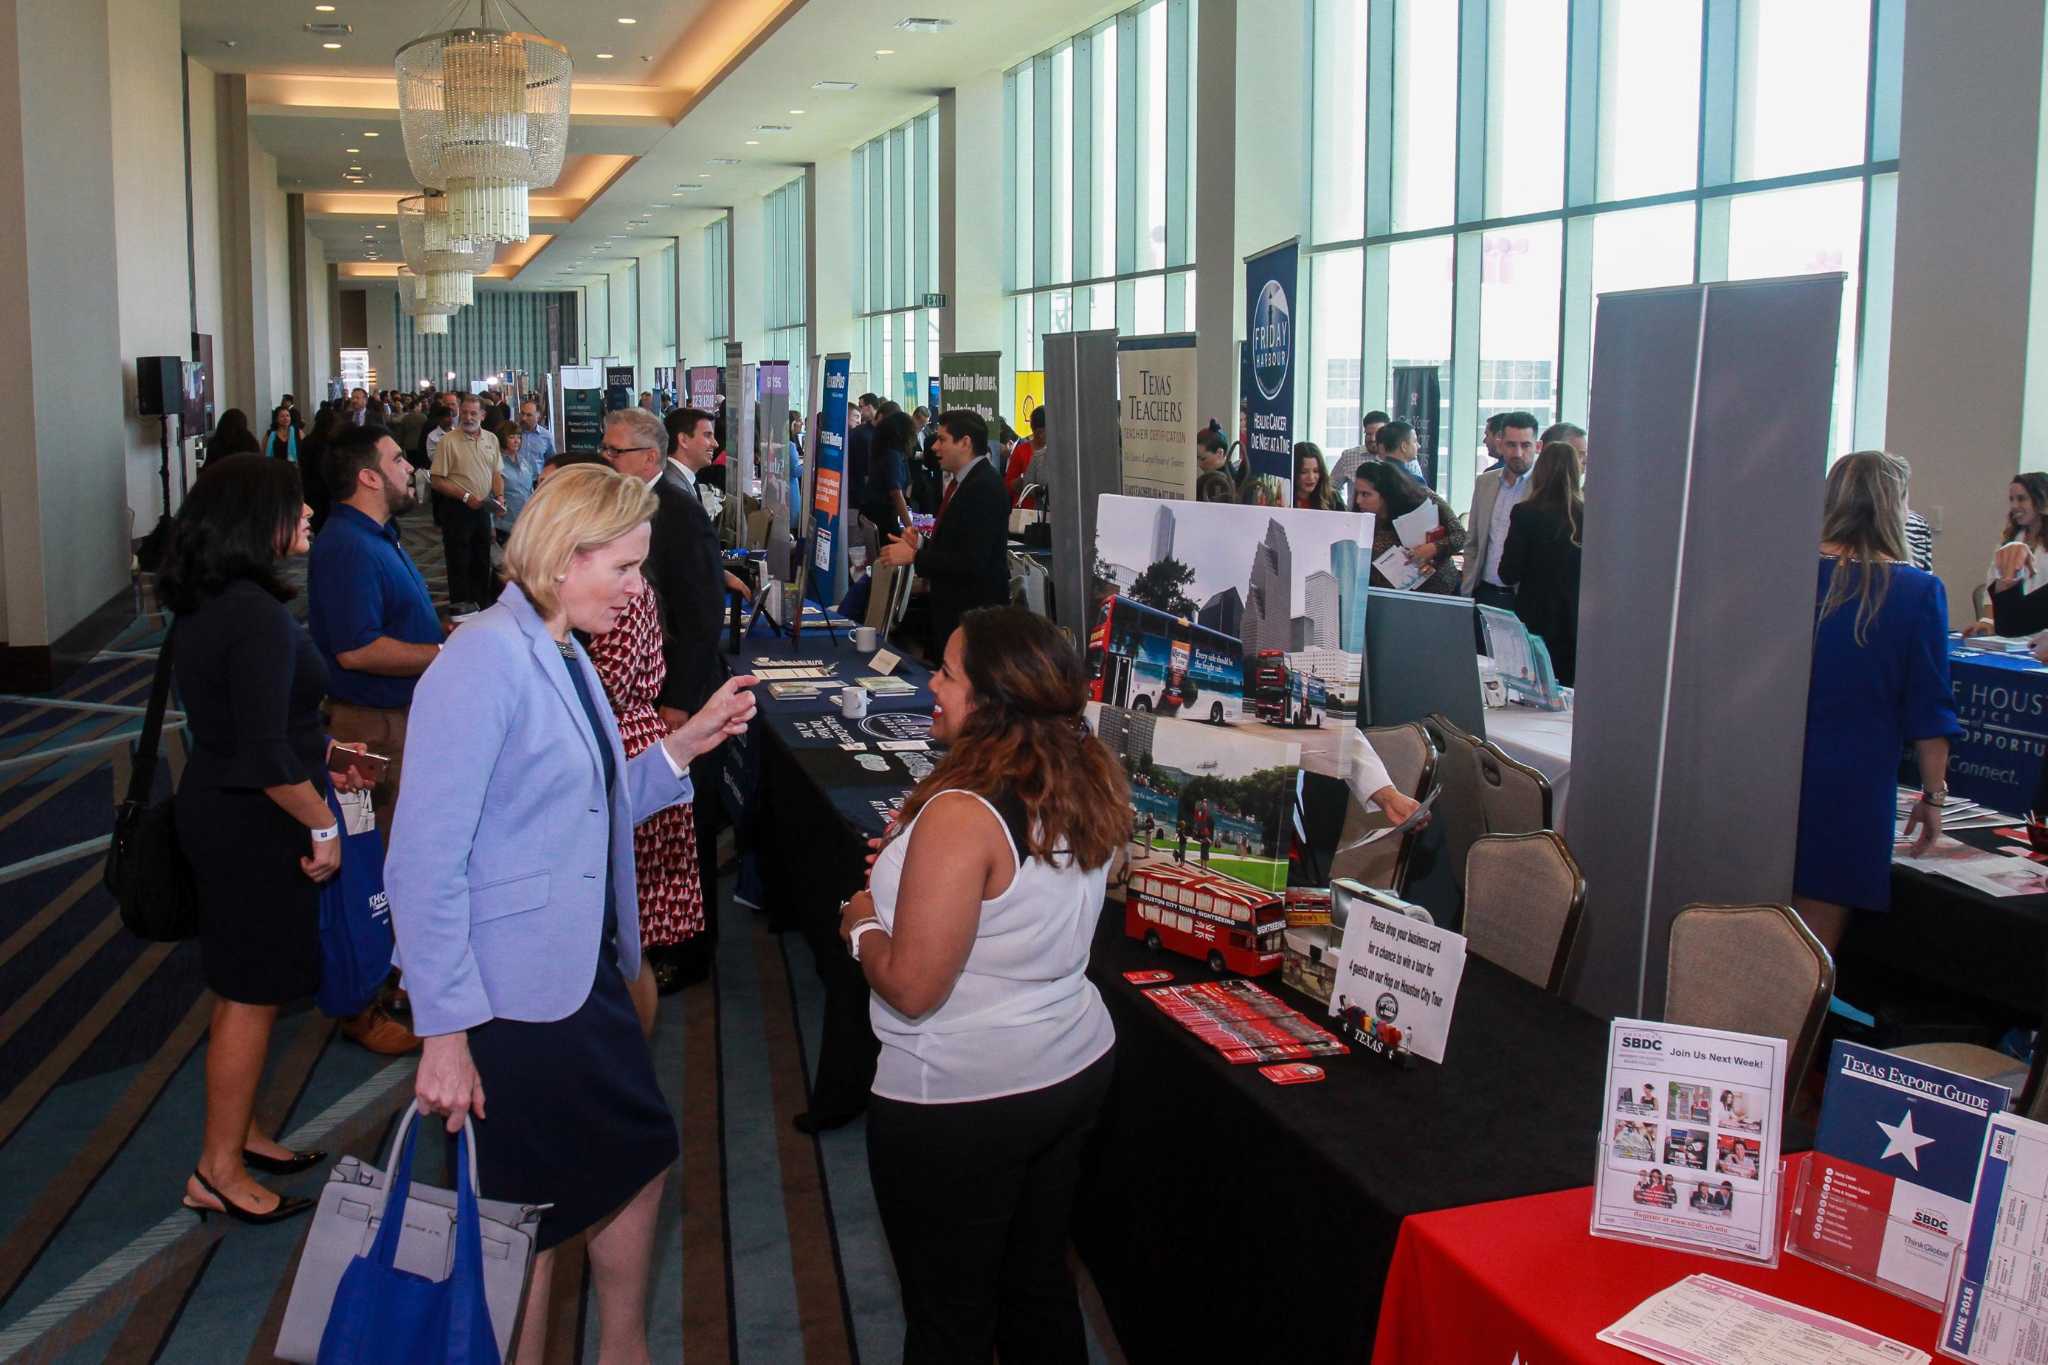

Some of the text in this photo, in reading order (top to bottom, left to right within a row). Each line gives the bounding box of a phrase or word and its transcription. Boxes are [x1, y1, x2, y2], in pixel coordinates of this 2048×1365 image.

[1255, 319, 1288, 347] FRIDAY
[1256, 350, 1286, 368] HARBOUR
[944, 373, 974, 392] Repairing
[1971, 684, 2048, 716] HOUS
[1960, 705, 2011, 723] FFICE
[1948, 754, 2019, 785] Connect.
[1140, 894, 1165, 906] HOUSTON
[1166, 902, 1178, 910] CITY
[1178, 905, 1196, 915] TOURS
[1256, 919, 1287, 936] SIGHTSEEING
[1370, 916, 1441, 953] Please drop your business card
[1379, 947, 1396, 963] chance
[1396, 951, 1402, 964] to
[1402, 955, 1411, 969] win
[1415, 960, 1427, 975] tour
[1352, 963, 1368, 978] guests
[1368, 970, 1374, 979] on
[1374, 971, 1384, 983] our
[1384, 973, 1393, 988] Hop
[1394, 980, 1400, 989] on
[1400, 979, 1420, 998] Houston
[1420, 987, 1431, 1005] City
[1430, 991, 1443, 1007] Tour
[1354, 1028, 1384, 1053] TEXAS
[1622, 1037, 1662, 1051] SBDC
[1670, 1048, 1691, 1058] Join
[1693, 1050, 1706, 1060] Us
[1709, 1053, 1731, 1064] Next
[1734, 1058, 1763, 1069] Week!
[1914, 1212, 1949, 1231] SBDC
[1953, 1287, 1975, 1346] JUNE 2018
